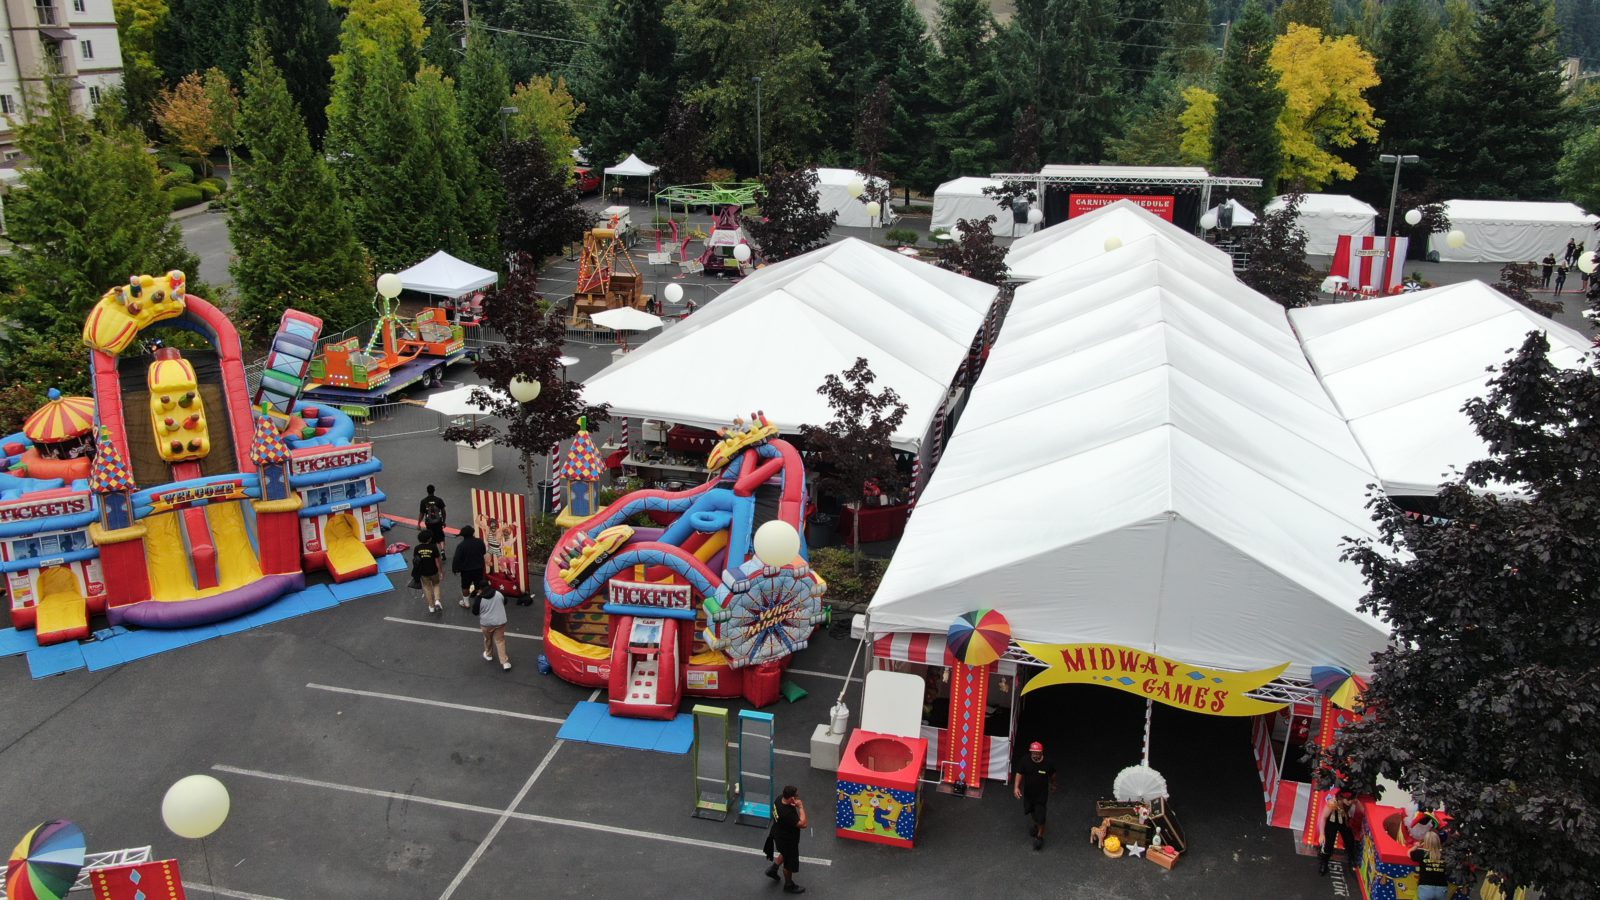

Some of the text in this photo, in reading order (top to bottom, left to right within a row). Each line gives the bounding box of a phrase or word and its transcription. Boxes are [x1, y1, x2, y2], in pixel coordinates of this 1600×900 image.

[296, 451, 368, 473] TICKETS
[164, 484, 234, 504] WELCOME
[0, 499, 85, 521] TICKETS
[612, 585, 688, 608] TICKETS
[1060, 647, 1179, 677] MIDWAY
[1142, 678, 1229, 713] GAMES
[1328, 860, 1350, 897] ISITOR
